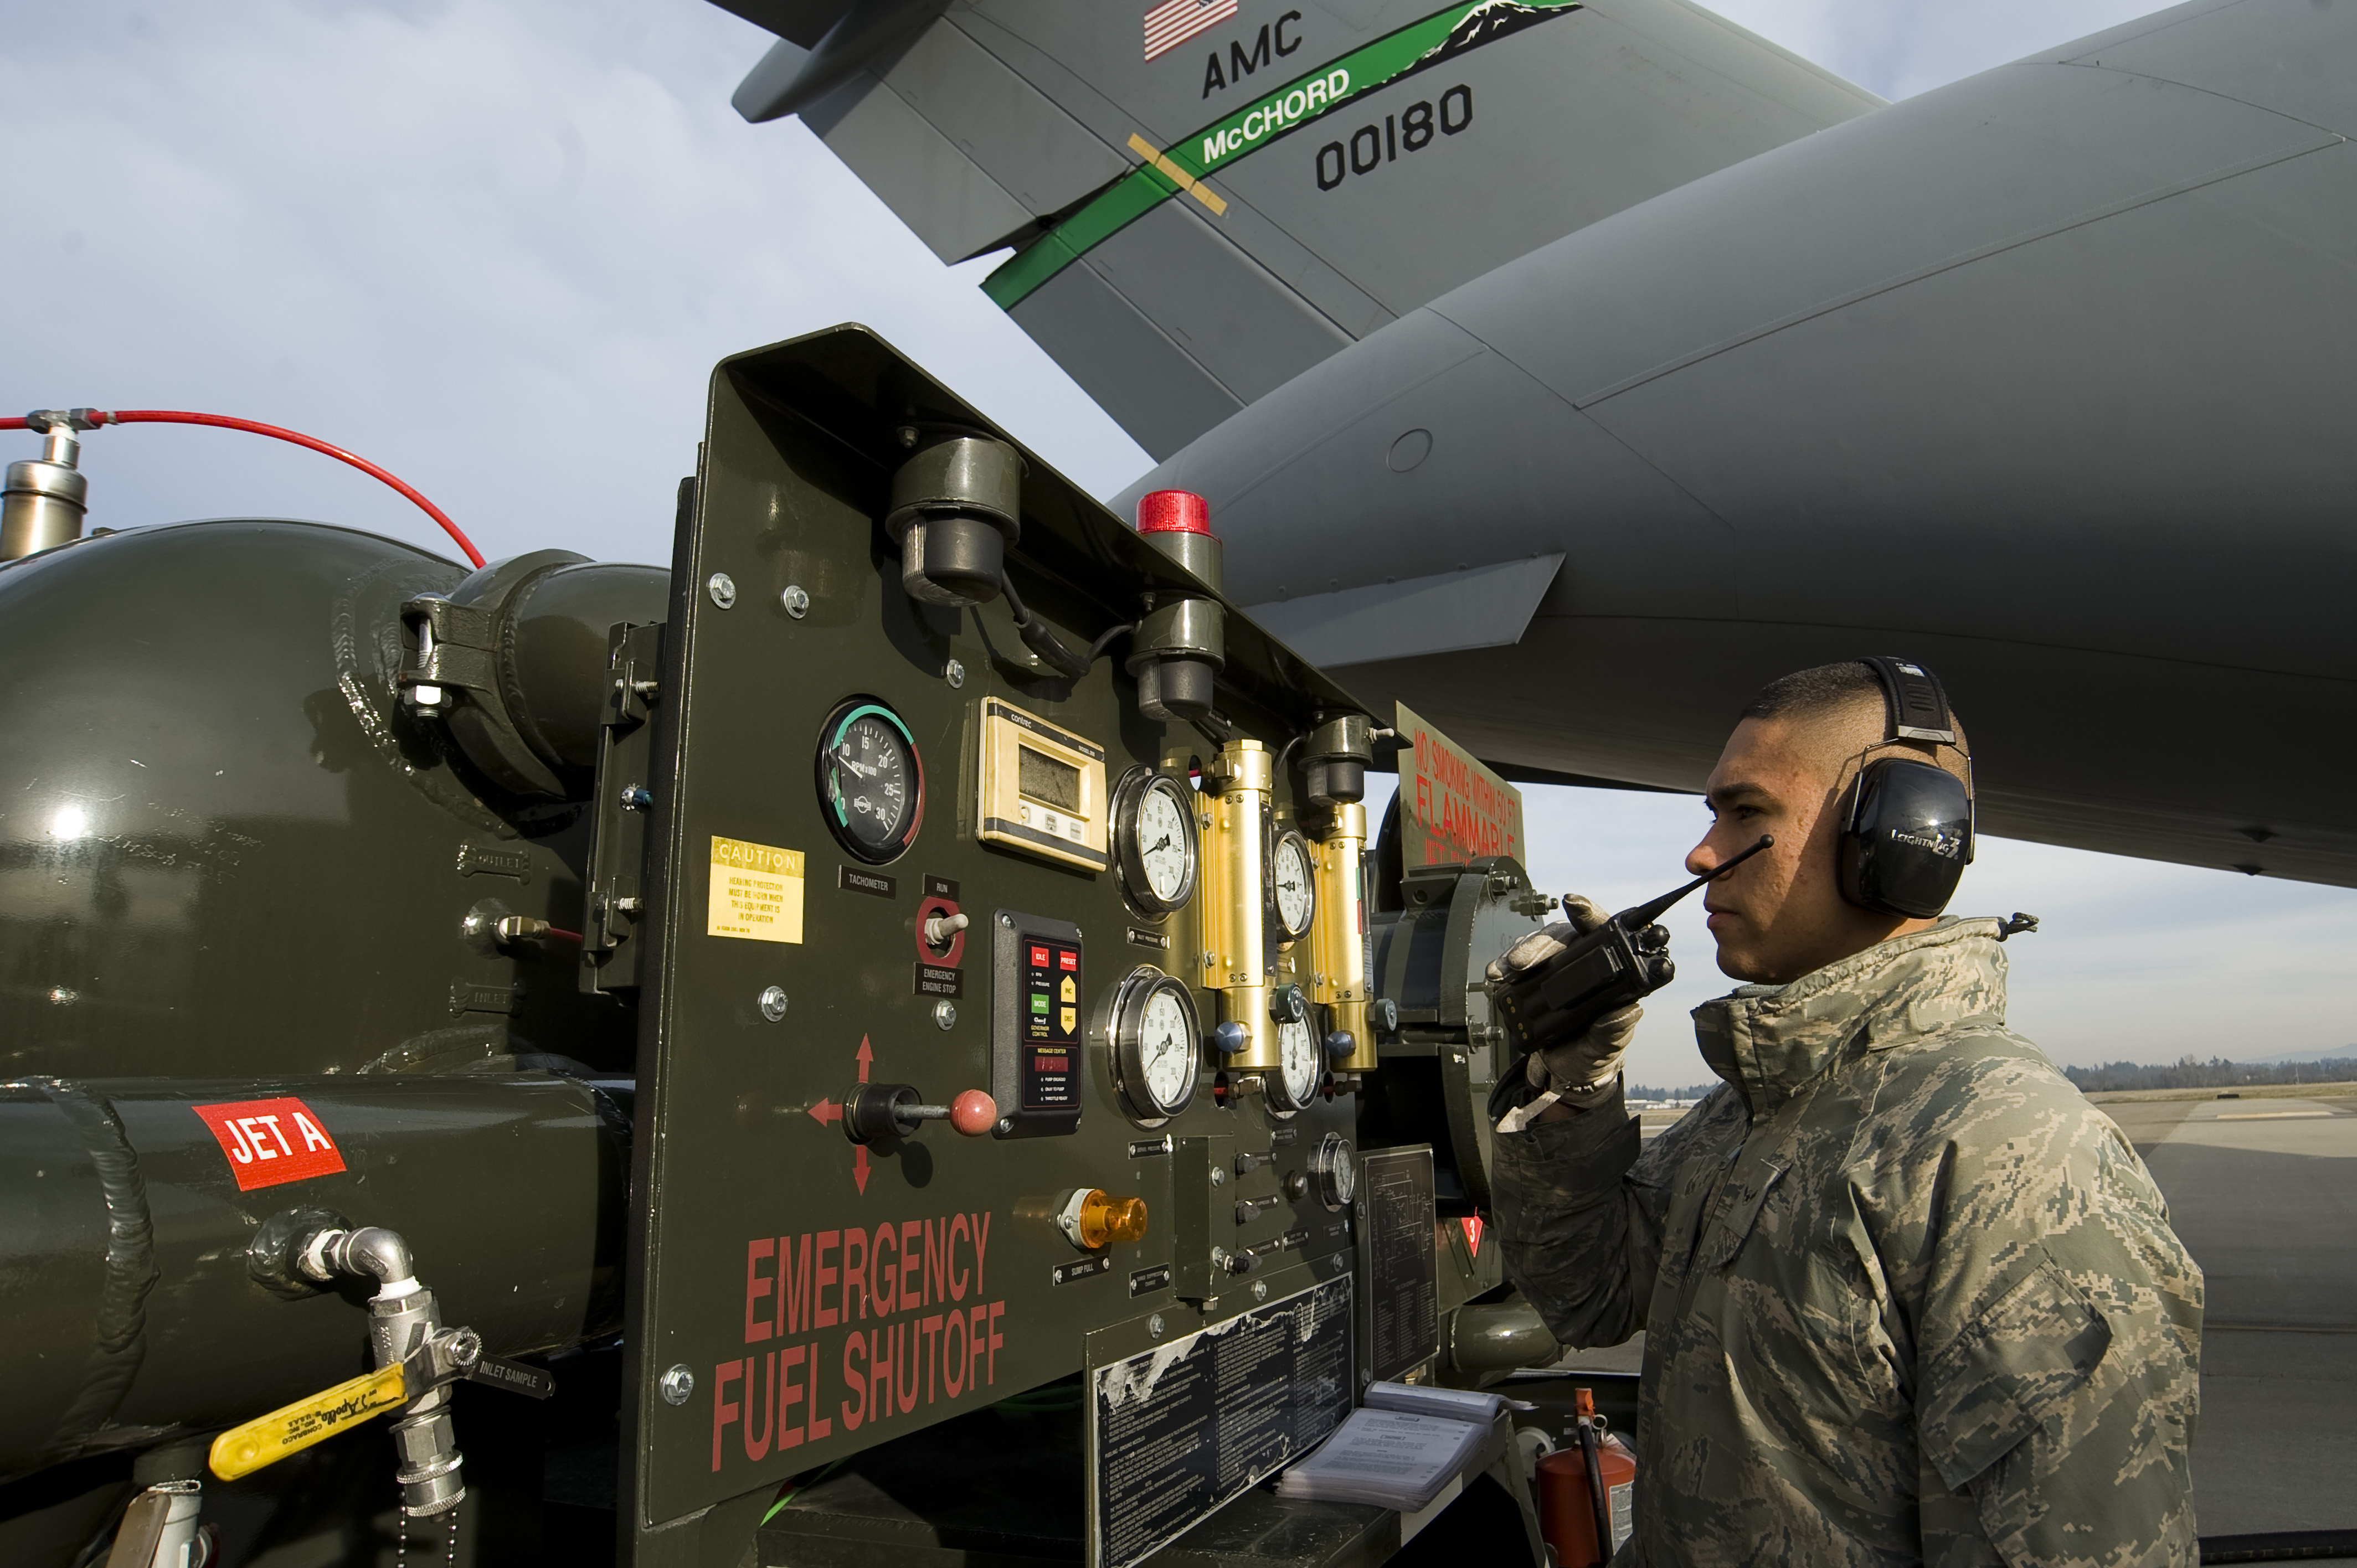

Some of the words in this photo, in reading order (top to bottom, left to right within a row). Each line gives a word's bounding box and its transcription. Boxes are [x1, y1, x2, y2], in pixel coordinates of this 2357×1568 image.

[1202, 10, 1303, 100] AMC
[1202, 68, 1350, 164] McCHORD
[1315, 83, 1474, 192] 00180
[1011, 713, 1032, 729] contrec
[842, 742, 850, 756] 10
[862, 736, 869, 750] 15
[878, 755, 887, 768] 20
[1414, 728, 1429, 773] NO
[1432, 739, 1470, 801] SMOKING
[1471, 769, 1496, 819] WITHIN
[884, 783, 893, 796] 25
[876, 807, 886, 820] 30
[479, 855, 519, 868] OUTLET
[719, 844, 795, 870] CAUTION
[729, 876, 752, 887] HEARING
[753, 880, 783, 892] PROTECTION
[849, 873, 888, 891] TACHOMETER
[936, 883, 948, 893] RUN
[729, 888, 743, 897] MUST
[744, 890, 751, 899] BE
[769, 894, 783, 902] WHEN
[744, 902, 773, 912] EQUIPMENT
[745, 914, 773, 924] OPERATION
[1036, 953, 1046, 961] IDLE
[1061, 957, 1076, 966] PRESET
[924, 968, 955, 981] EMERGENCY
[923, 981, 941, 992] ENGINE
[943, 983, 956, 994] STOP
[474, 992, 508, 1004] INLET
[224, 1115, 293, 1164] JET
[292, 1112, 332, 1152] A
[1469, 1219, 1476, 1243] 3
[1072, 1265, 1083, 1276] SUMP
[1084, 1263, 1094, 1273] FULL
[744, 1211, 991, 1344] EMERGENCY
[480, 1360, 505, 1380] INLET
[505, 1368, 538, 1388] SAMPLE
[712, 1342, 832, 1472] FUEL
[841, 1301, 1005, 1431] SHUTOFF
[321, 1397, 359, 1425] Apollo
[282, 1423, 322, 1445] CONBRACO
